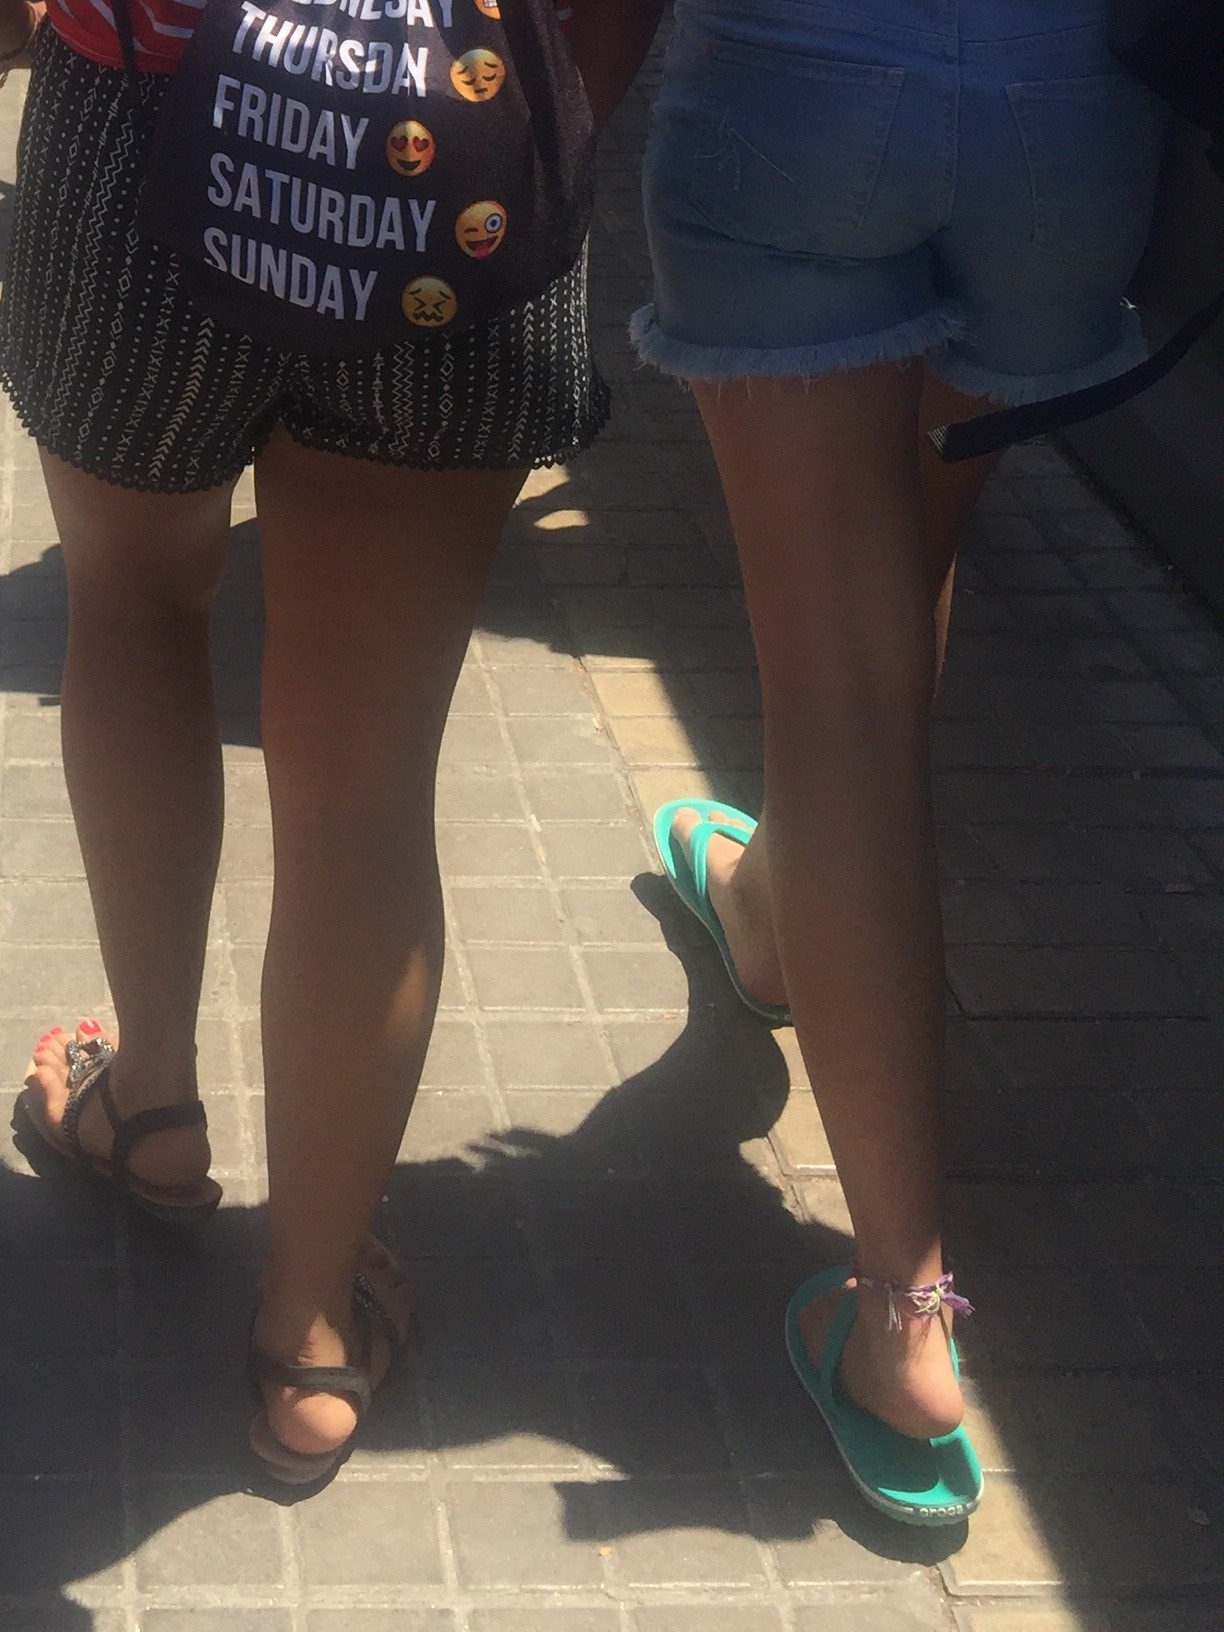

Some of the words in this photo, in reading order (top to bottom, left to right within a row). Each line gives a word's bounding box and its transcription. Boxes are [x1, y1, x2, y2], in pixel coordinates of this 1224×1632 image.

[212, 73, 369, 170] FRIDAY
[207, 152, 437, 253] SATURDAY
[203, 227, 378, 321] SUNDAY
